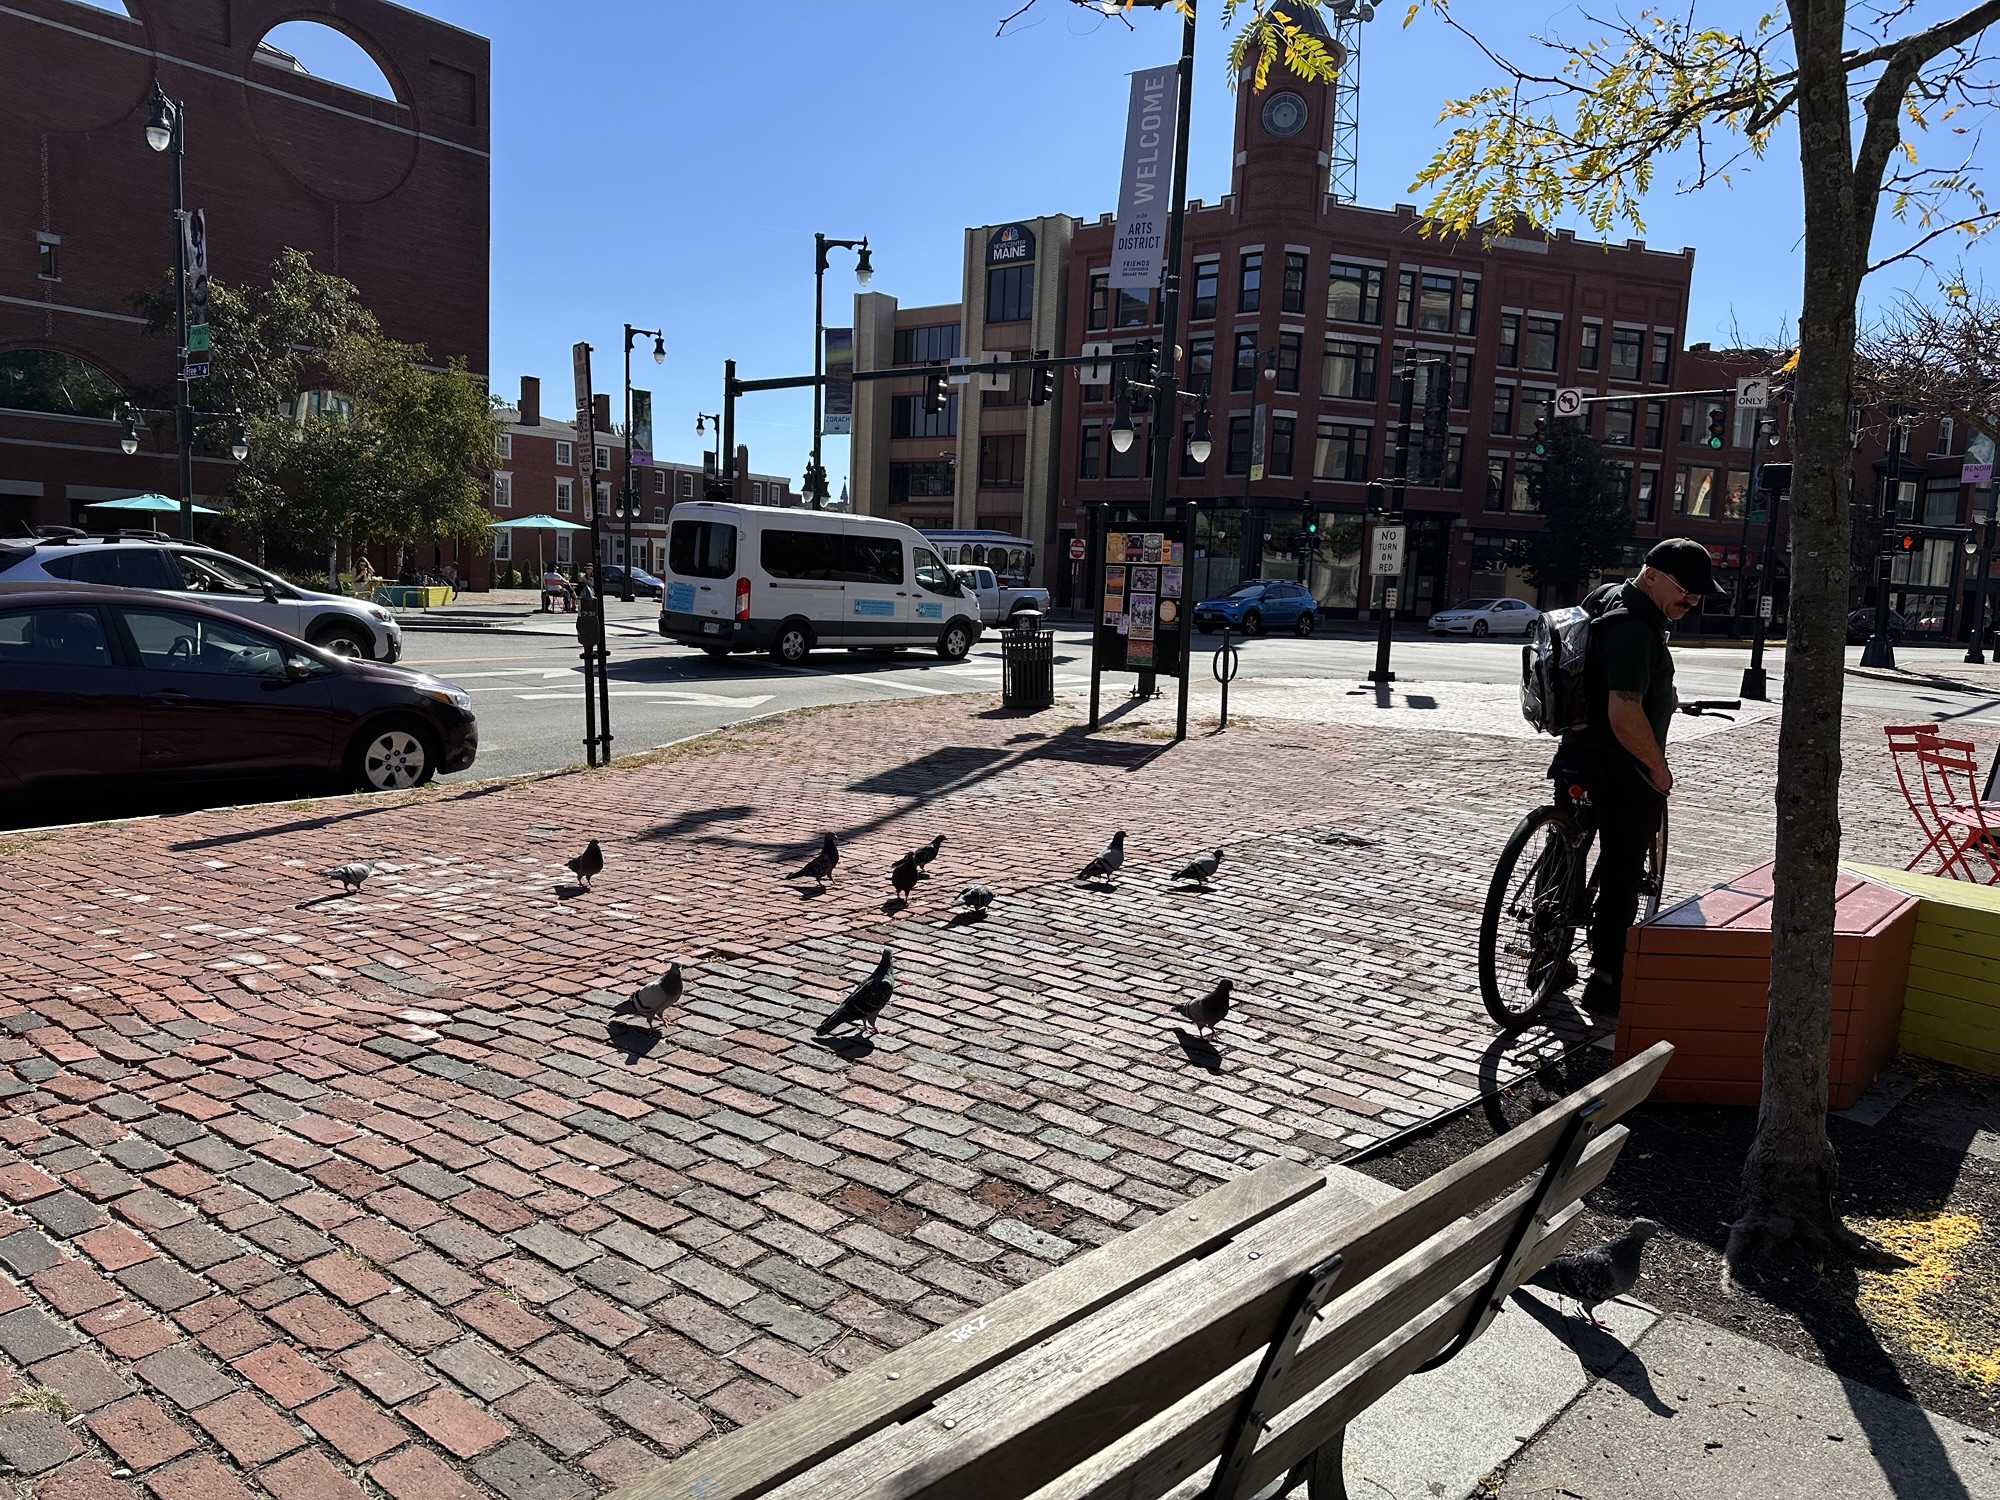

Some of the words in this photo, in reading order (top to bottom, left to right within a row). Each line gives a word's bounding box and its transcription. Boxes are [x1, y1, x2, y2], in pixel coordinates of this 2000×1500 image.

[1133, 75, 1165, 206] WELCOME
[1128, 222, 1153, 235] ARTS
[1118, 236, 1160, 250] DISTRICT
[993, 245, 1026, 261] MAINE
[186, 366, 197, 376] Free
[1738, 397, 1764, 405] ONLY
[1964, 464, 1992, 472] RENOIR
[1381, 530, 1397, 541] NO
[1379, 543, 1398, 551] TURN
[1381, 553, 1393, 561] ON
[1378, 563, 1394, 572] RED
